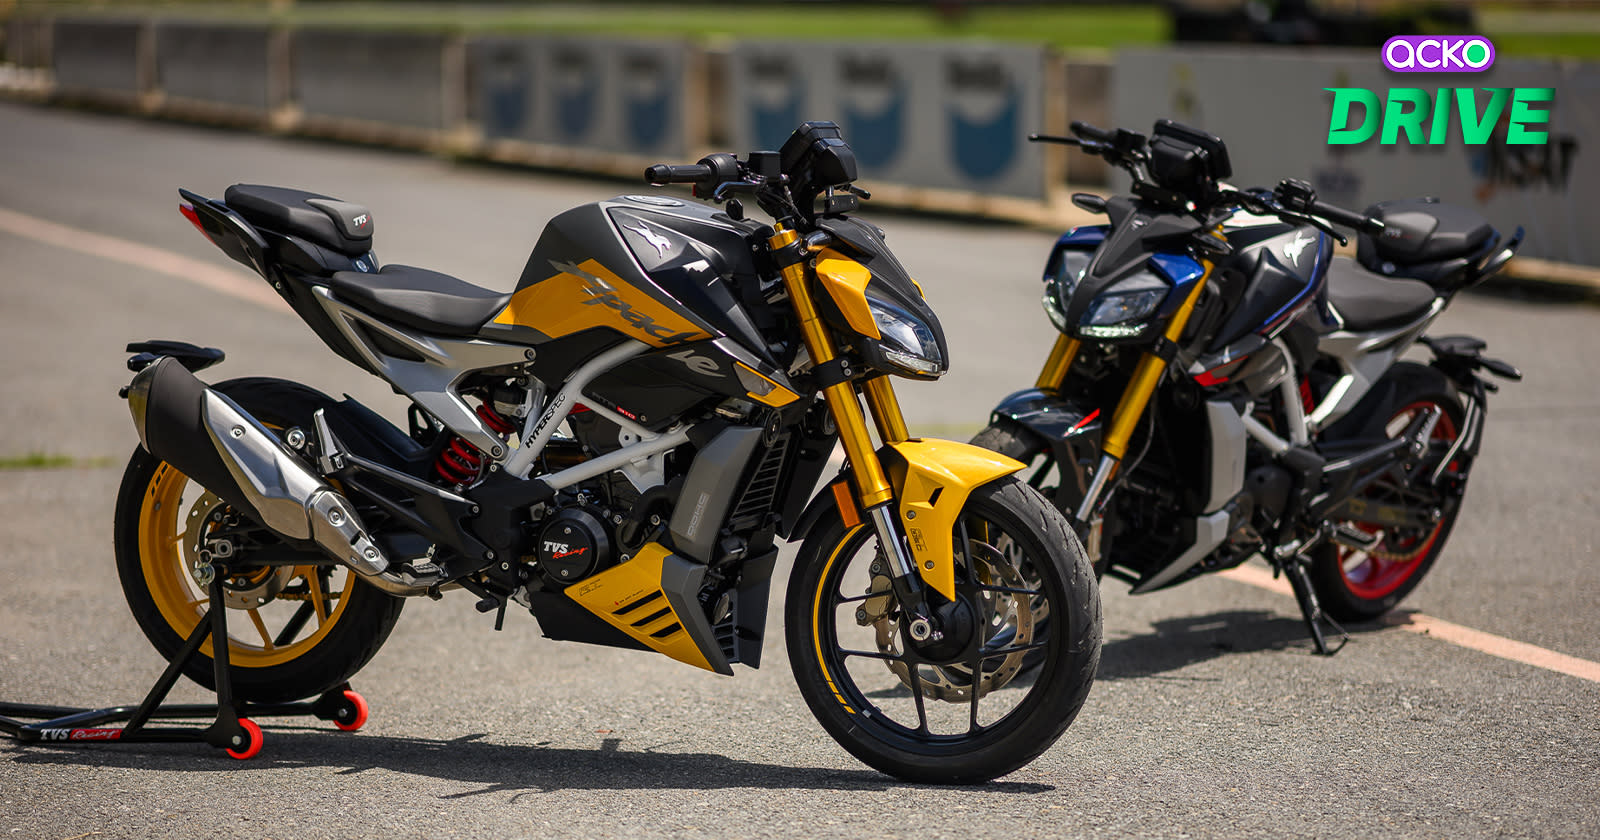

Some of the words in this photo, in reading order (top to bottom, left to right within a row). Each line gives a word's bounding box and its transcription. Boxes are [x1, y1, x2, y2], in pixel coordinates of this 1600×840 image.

[353, 214, 367, 227] TVS
[525, 392, 566, 448] HYPERSPEC
[544, 541, 569, 554] TVS
[552, 547, 589, 559] Racing
[40, 728, 70, 740] TVS
[72, 729, 121, 739] Racing
